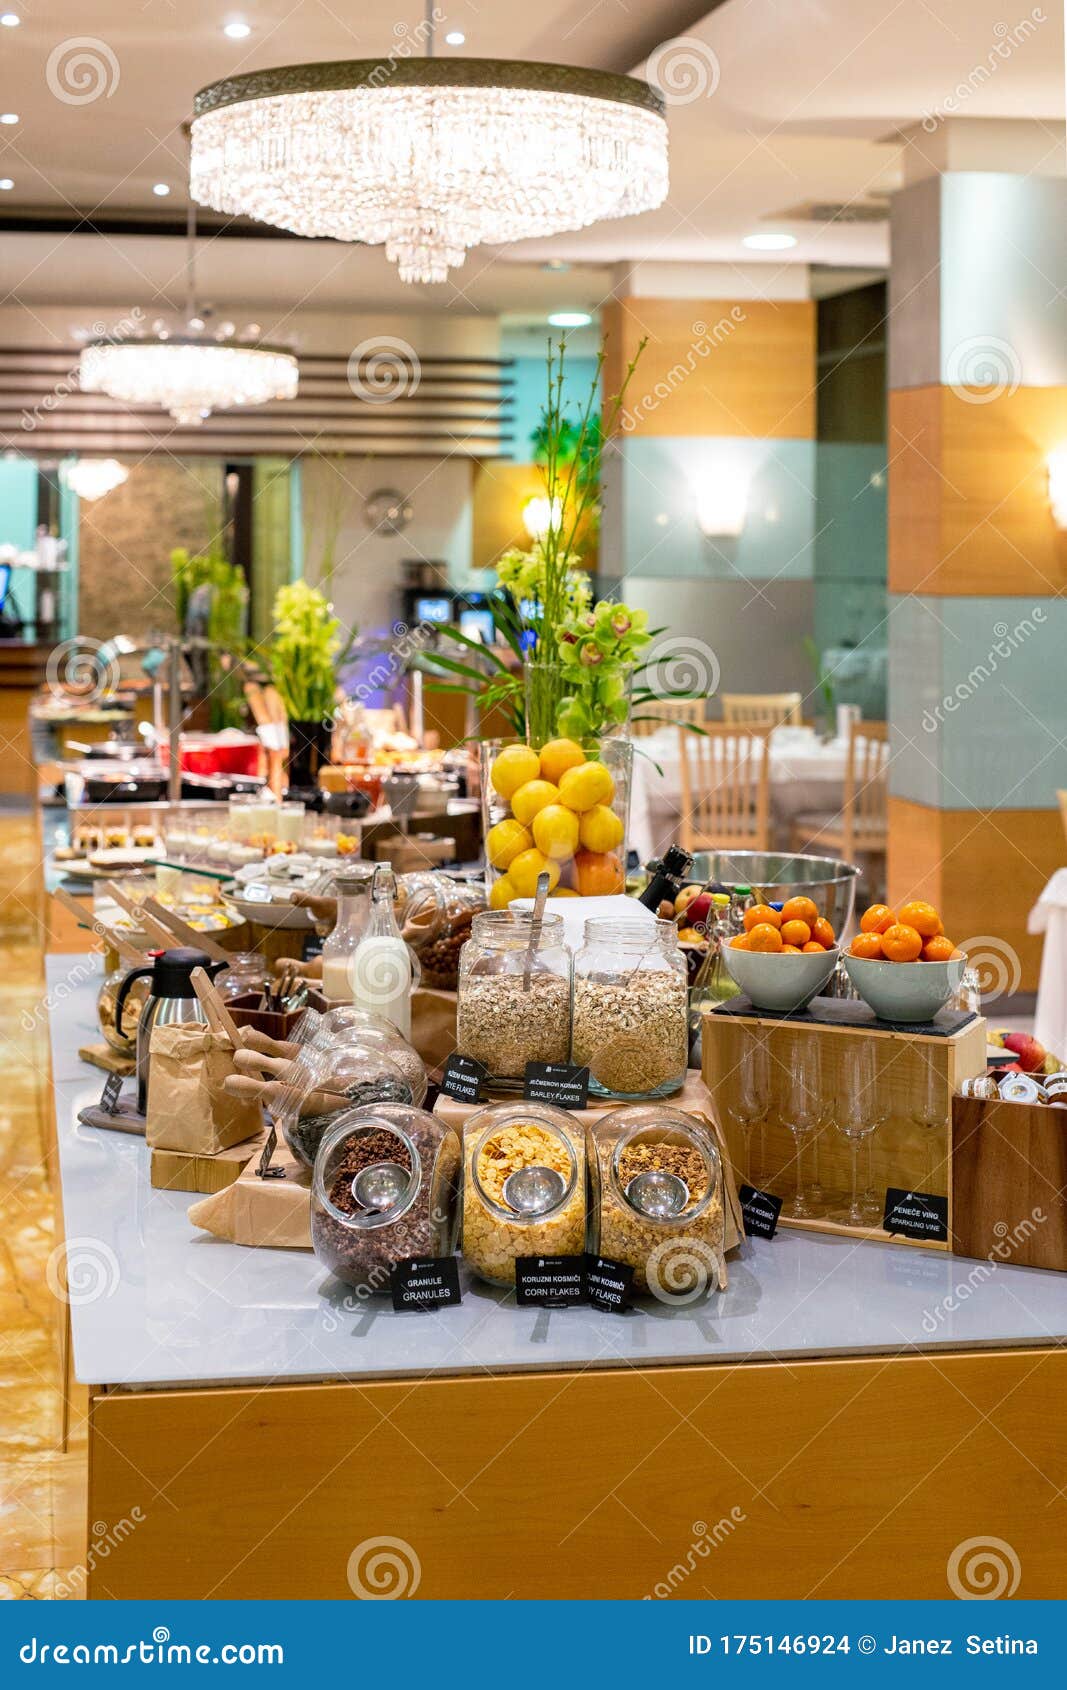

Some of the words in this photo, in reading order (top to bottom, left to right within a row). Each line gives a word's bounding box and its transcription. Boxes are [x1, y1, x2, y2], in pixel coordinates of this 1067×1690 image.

[445, 1081, 457, 1091] RYE
[457, 1084, 476, 1096] FLAKES
[530, 1090, 555, 1099] BARLEY
[555, 1093, 580, 1101] FLAKES
[921, 1211, 939, 1220] VINO
[407, 1276, 442, 1287] GRANULE
[552, 1274, 581, 1283] KOSMIČI
[402, 1288, 451, 1301] GRANULES
[524, 1288, 548, 1297] CORN
[549, 1287, 580, 1297] FLAKES
[595, 1289, 621, 1304] FLAKES
